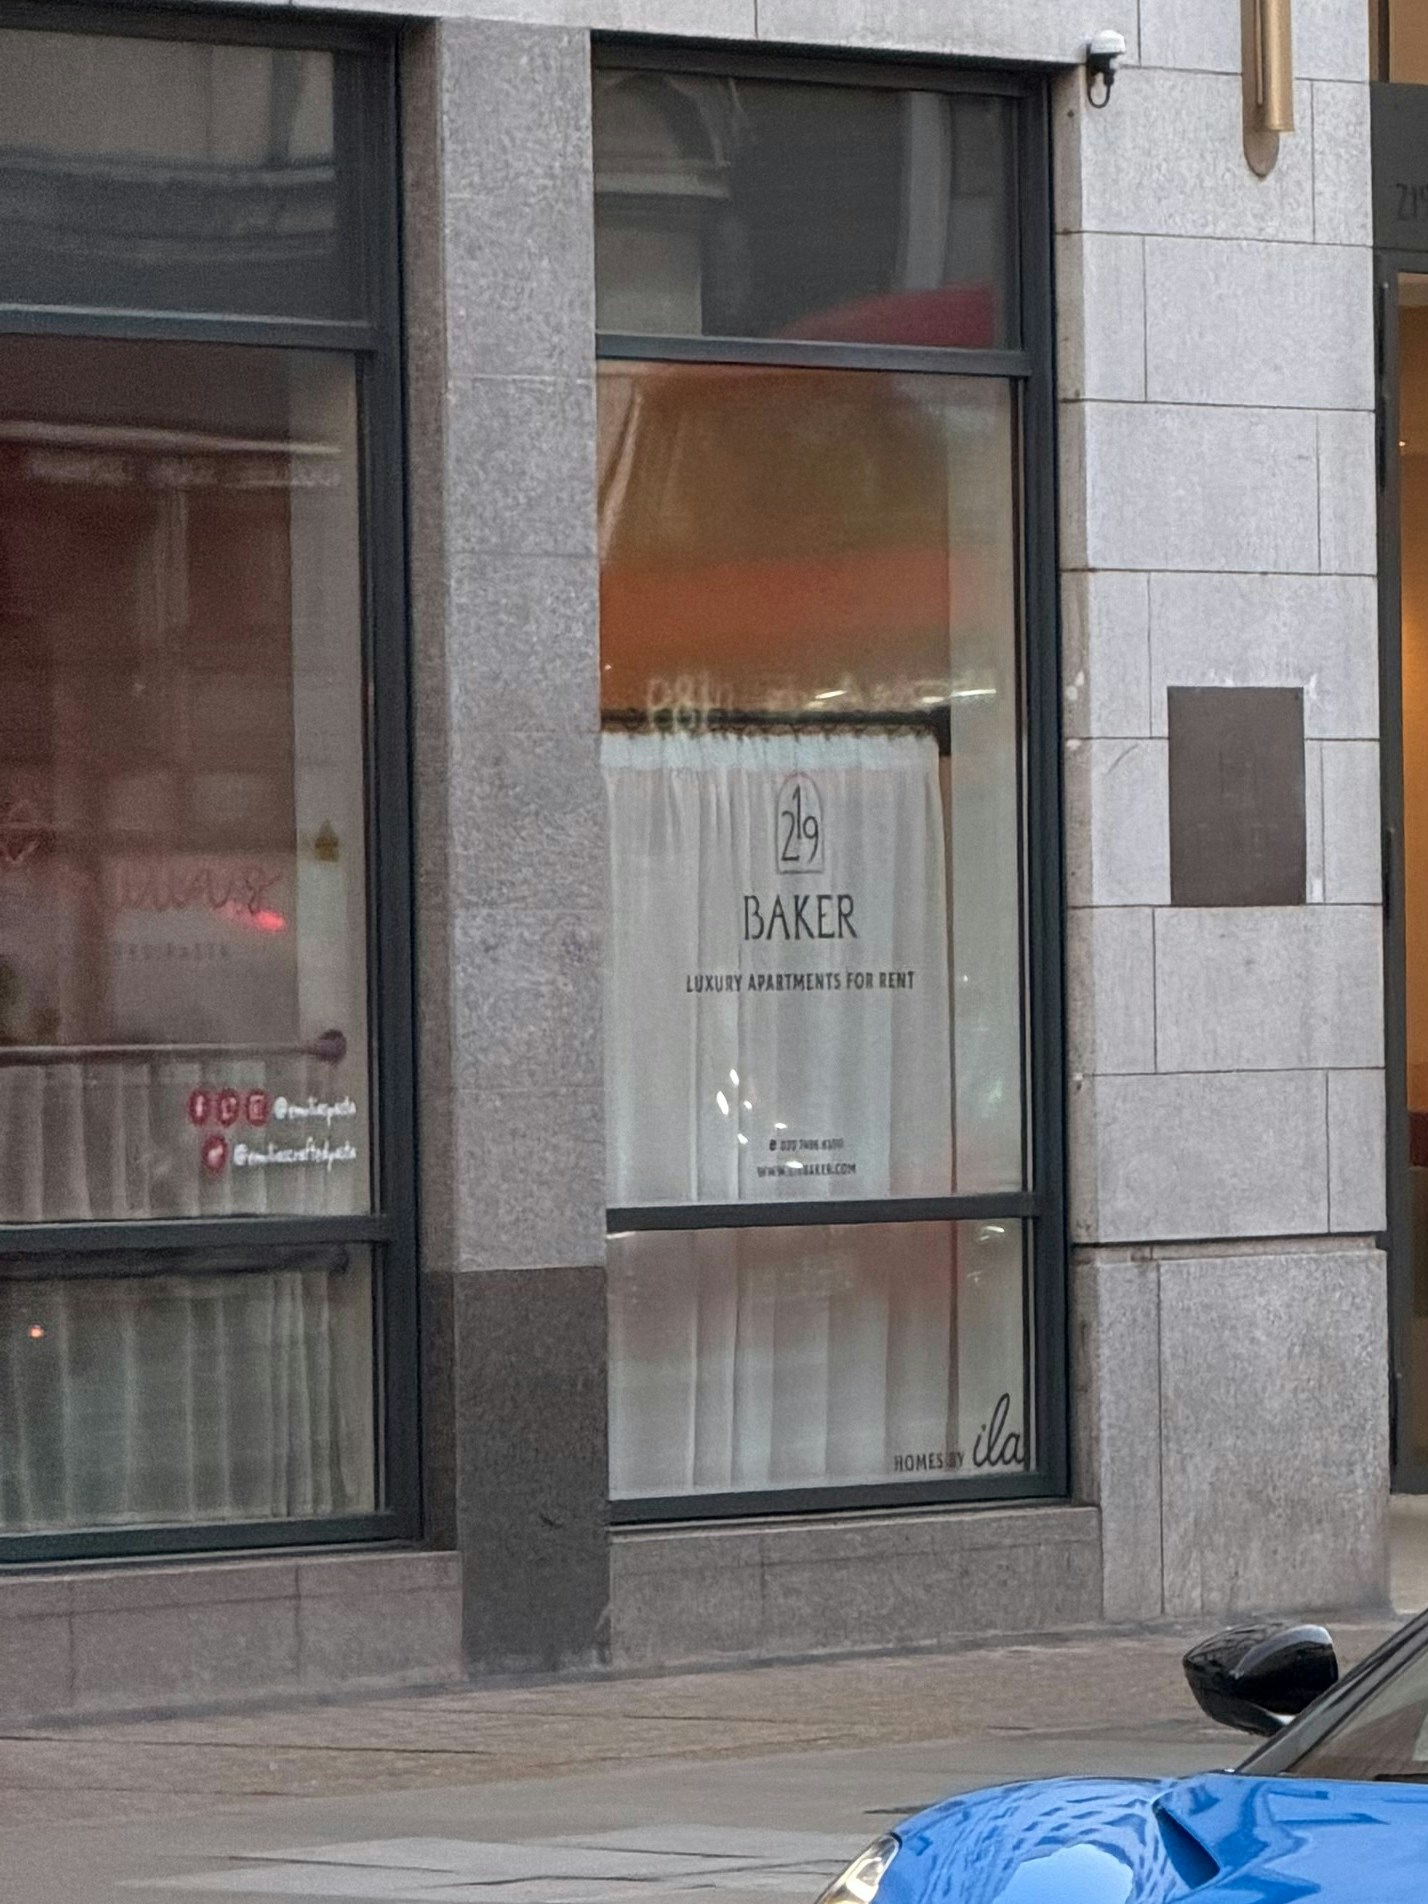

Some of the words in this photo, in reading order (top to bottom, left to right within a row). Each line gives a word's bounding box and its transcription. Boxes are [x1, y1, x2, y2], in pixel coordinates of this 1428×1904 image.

[744, 894, 859, 941] BAKER
[686, 974, 743, 993] LUXURY
[747, 972, 841, 992] APARTMENTS
[846, 972, 873, 990] FOR
[879, 970, 915, 990] RENT
[894, 1452, 943, 1472] HOMES
[948, 1450, 965, 1469] BY
[972, 1392, 1025, 1467] ila
